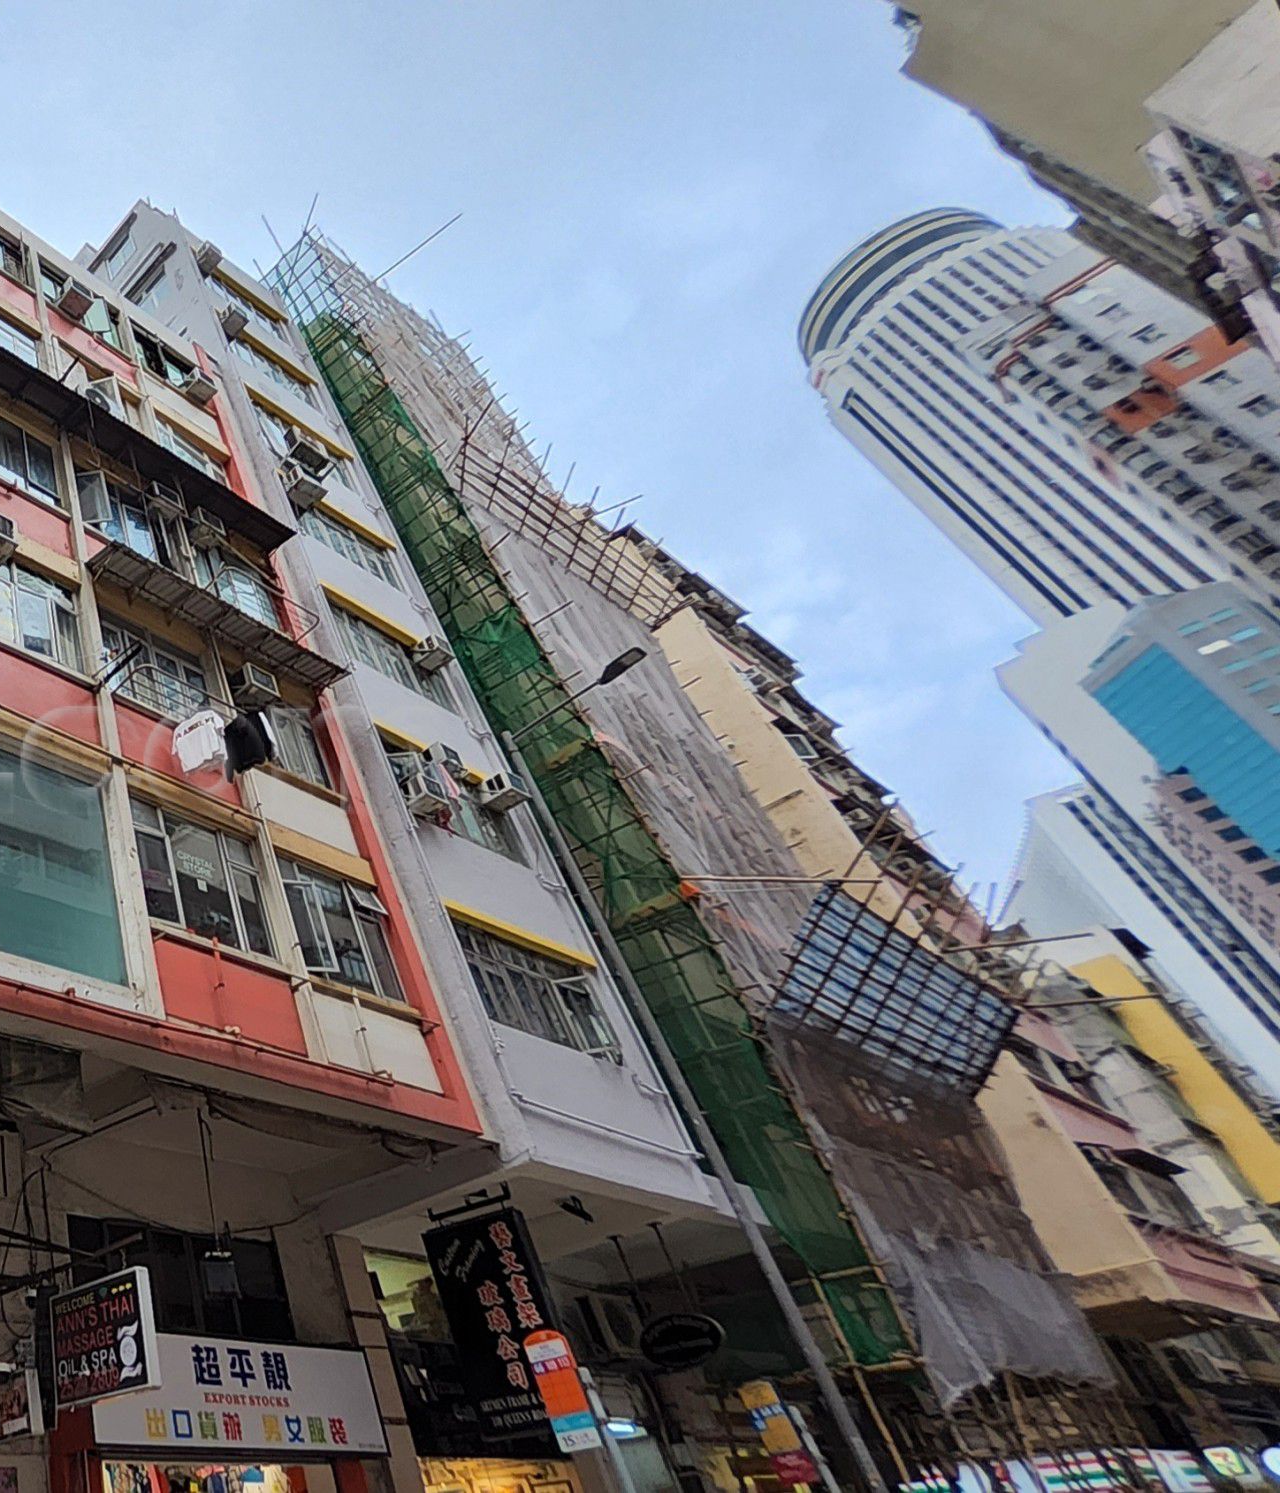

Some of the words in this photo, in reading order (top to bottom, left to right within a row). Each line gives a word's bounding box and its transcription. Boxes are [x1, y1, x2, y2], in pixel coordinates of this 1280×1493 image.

[54, 1291, 96, 1316] WELCOME
[55, 1305, 99, 1336] ANN'S
[99, 1293, 135, 1323] THAI
[56, 1325, 114, 1357] MASSAGE
[91, 1347, 118, 1370] SPA
[190, 1343, 292, 1392] 超平靚
[204, 1392, 247, 1406] EXPORT
[249, 1394, 291, 1408] STOCKS
